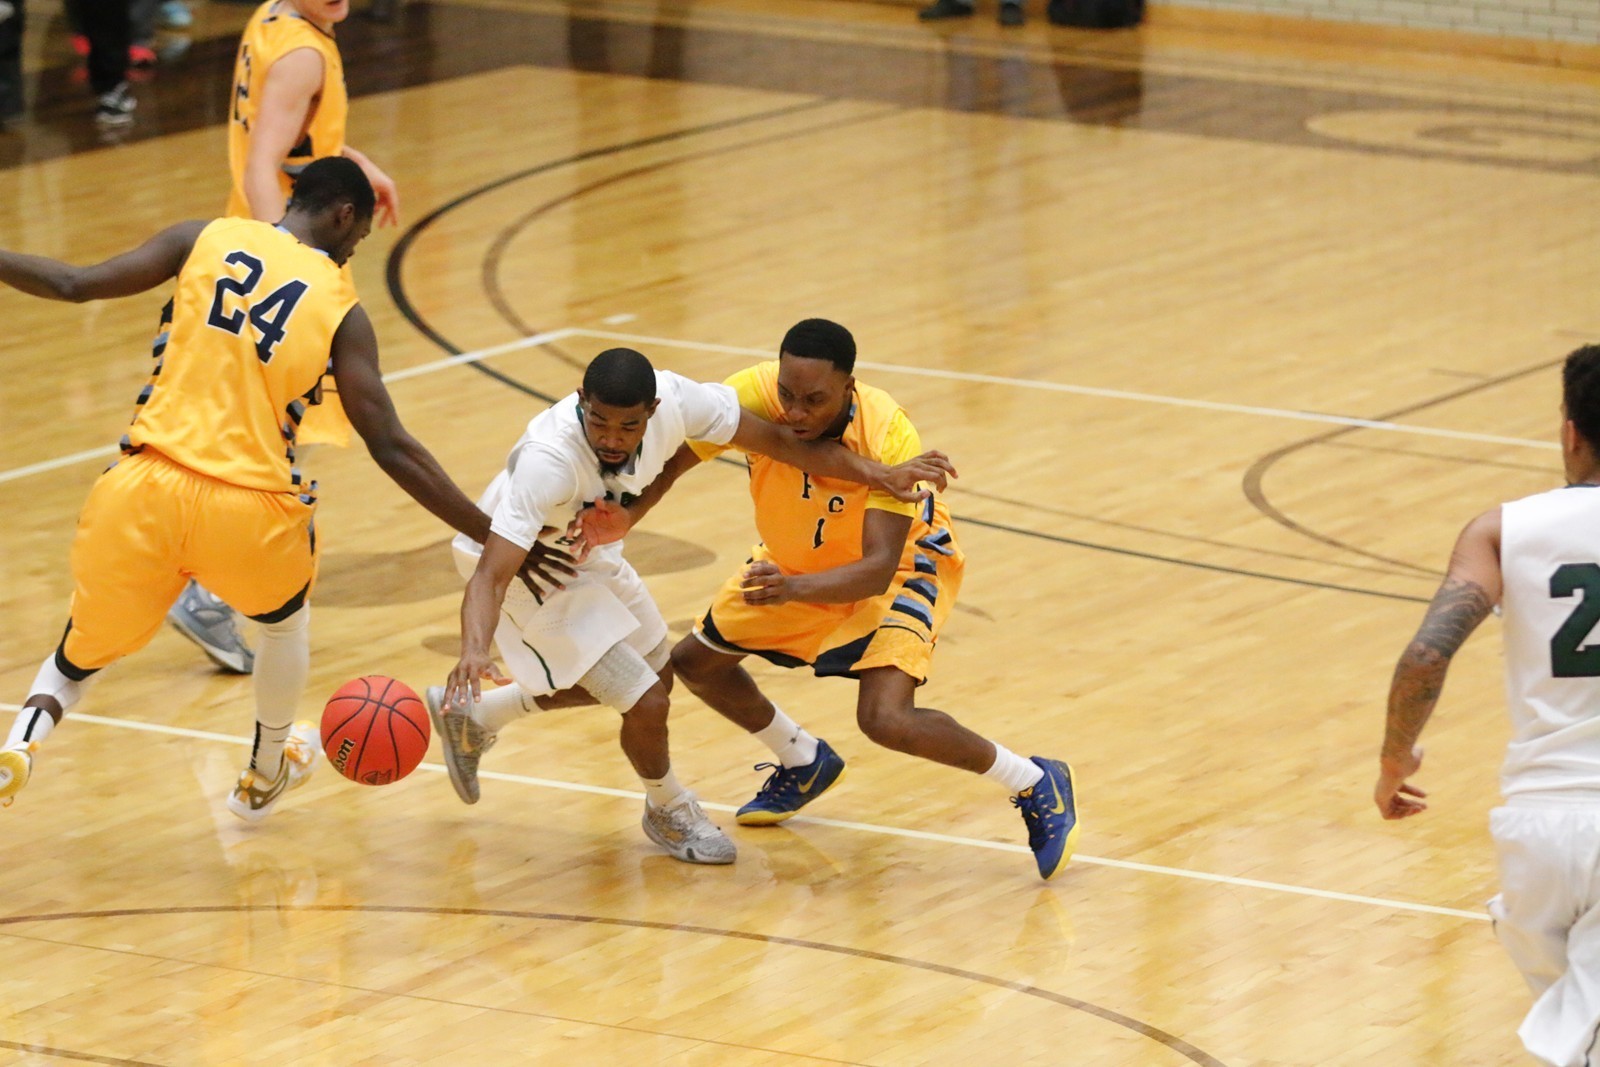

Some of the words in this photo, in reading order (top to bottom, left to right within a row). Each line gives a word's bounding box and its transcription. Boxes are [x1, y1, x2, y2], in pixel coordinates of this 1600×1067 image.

[206, 249, 310, 365] 24
[812, 517, 826, 550] 1
[1549, 562, 1600, 678] 2
